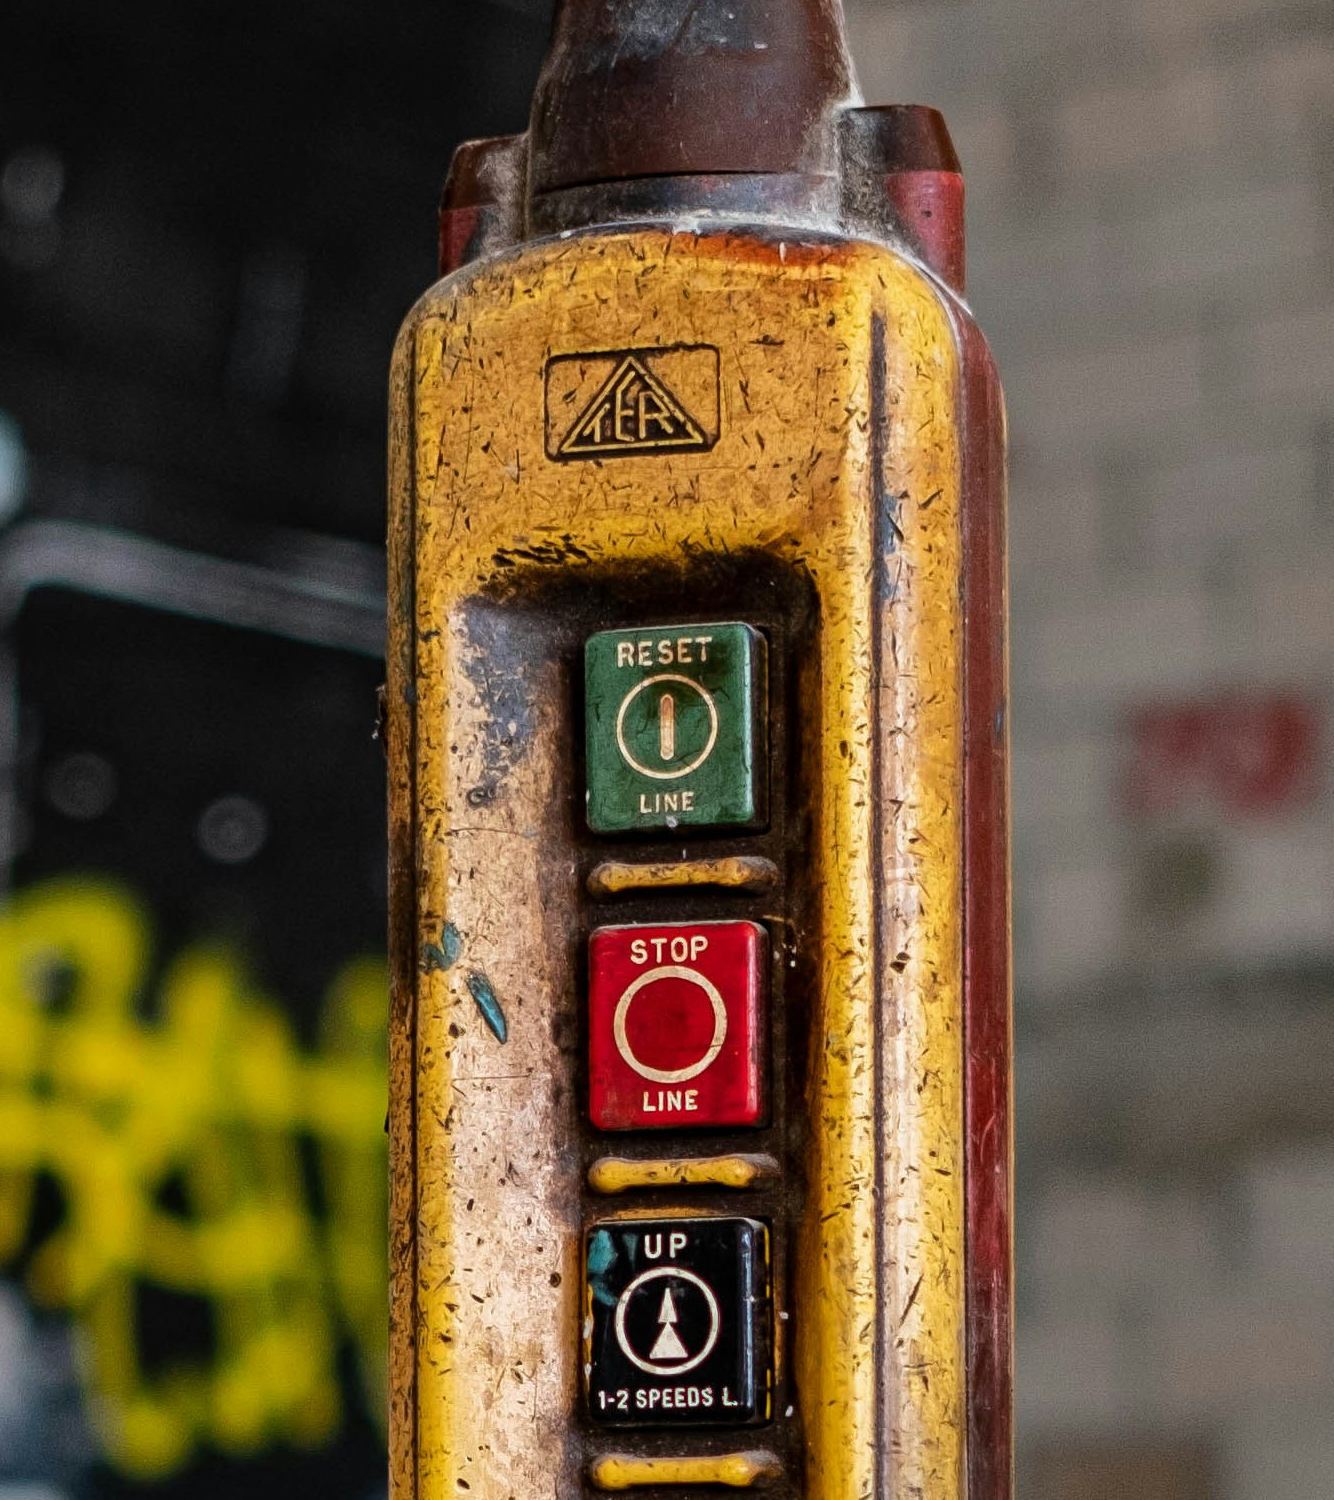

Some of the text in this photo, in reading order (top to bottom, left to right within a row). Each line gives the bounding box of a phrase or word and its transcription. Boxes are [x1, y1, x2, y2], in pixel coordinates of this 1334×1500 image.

[580, 368, 676, 444] TER
[616, 634, 714, 669] RESET
[638, 790, 696, 815] LINE
[629, 935, 710, 966] STOP
[641, 1089, 700, 1113] LINE
[643, 1231, 688, 1260] UP
[597, 1389, 630, 1411] 1-2
[634, 1386, 715, 1410] SPEEDS
